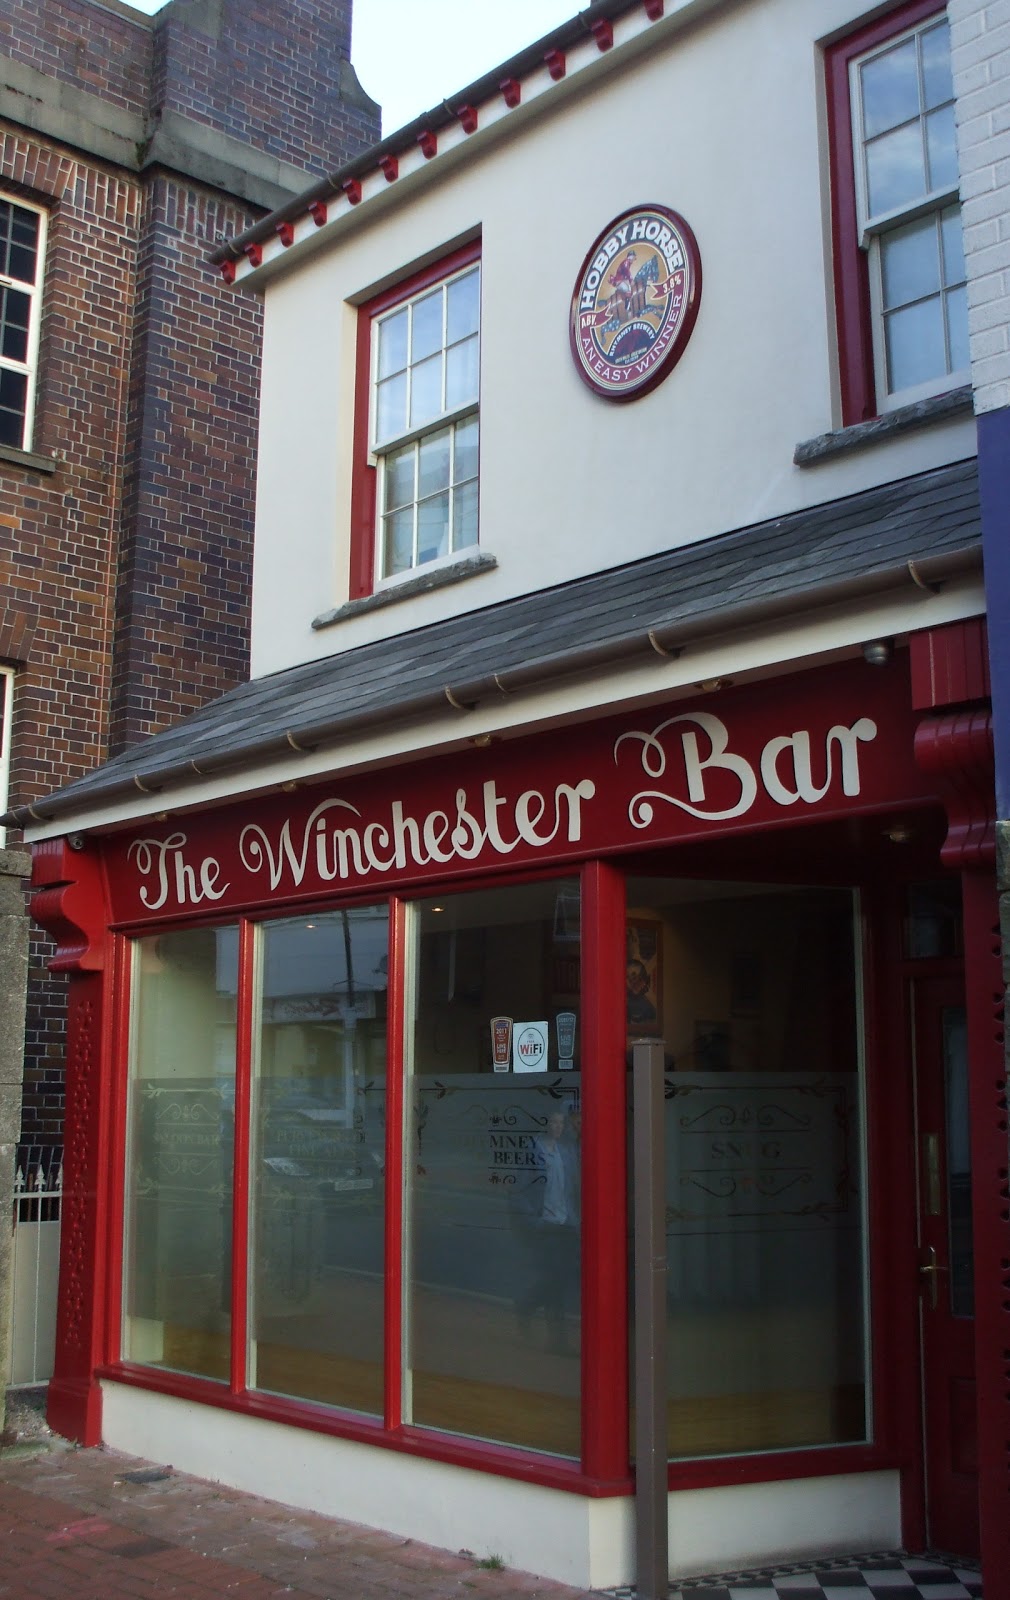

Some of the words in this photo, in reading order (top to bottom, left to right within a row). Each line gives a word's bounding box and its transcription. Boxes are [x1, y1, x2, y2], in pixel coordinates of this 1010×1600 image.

[581, 225, 629, 309] HOBBY
[630, 220, 683, 273] HORSE
[663, 275, 681, 293] 3.8%
[582, 337, 596, 362] AN
[594, 361, 632, 381] EASY
[636, 295, 682, 373] WINNER
[609, 326, 631, 357] RHYMNEY
[632, 323, 655, 339] BREWERY
[127, 832, 230, 910] The
[239, 779, 596, 891] Winchester
[614, 711, 877, 829] Bar
[520, 1043, 542, 1055] WiFi
[493, 1151, 547, 1165] BEERS
